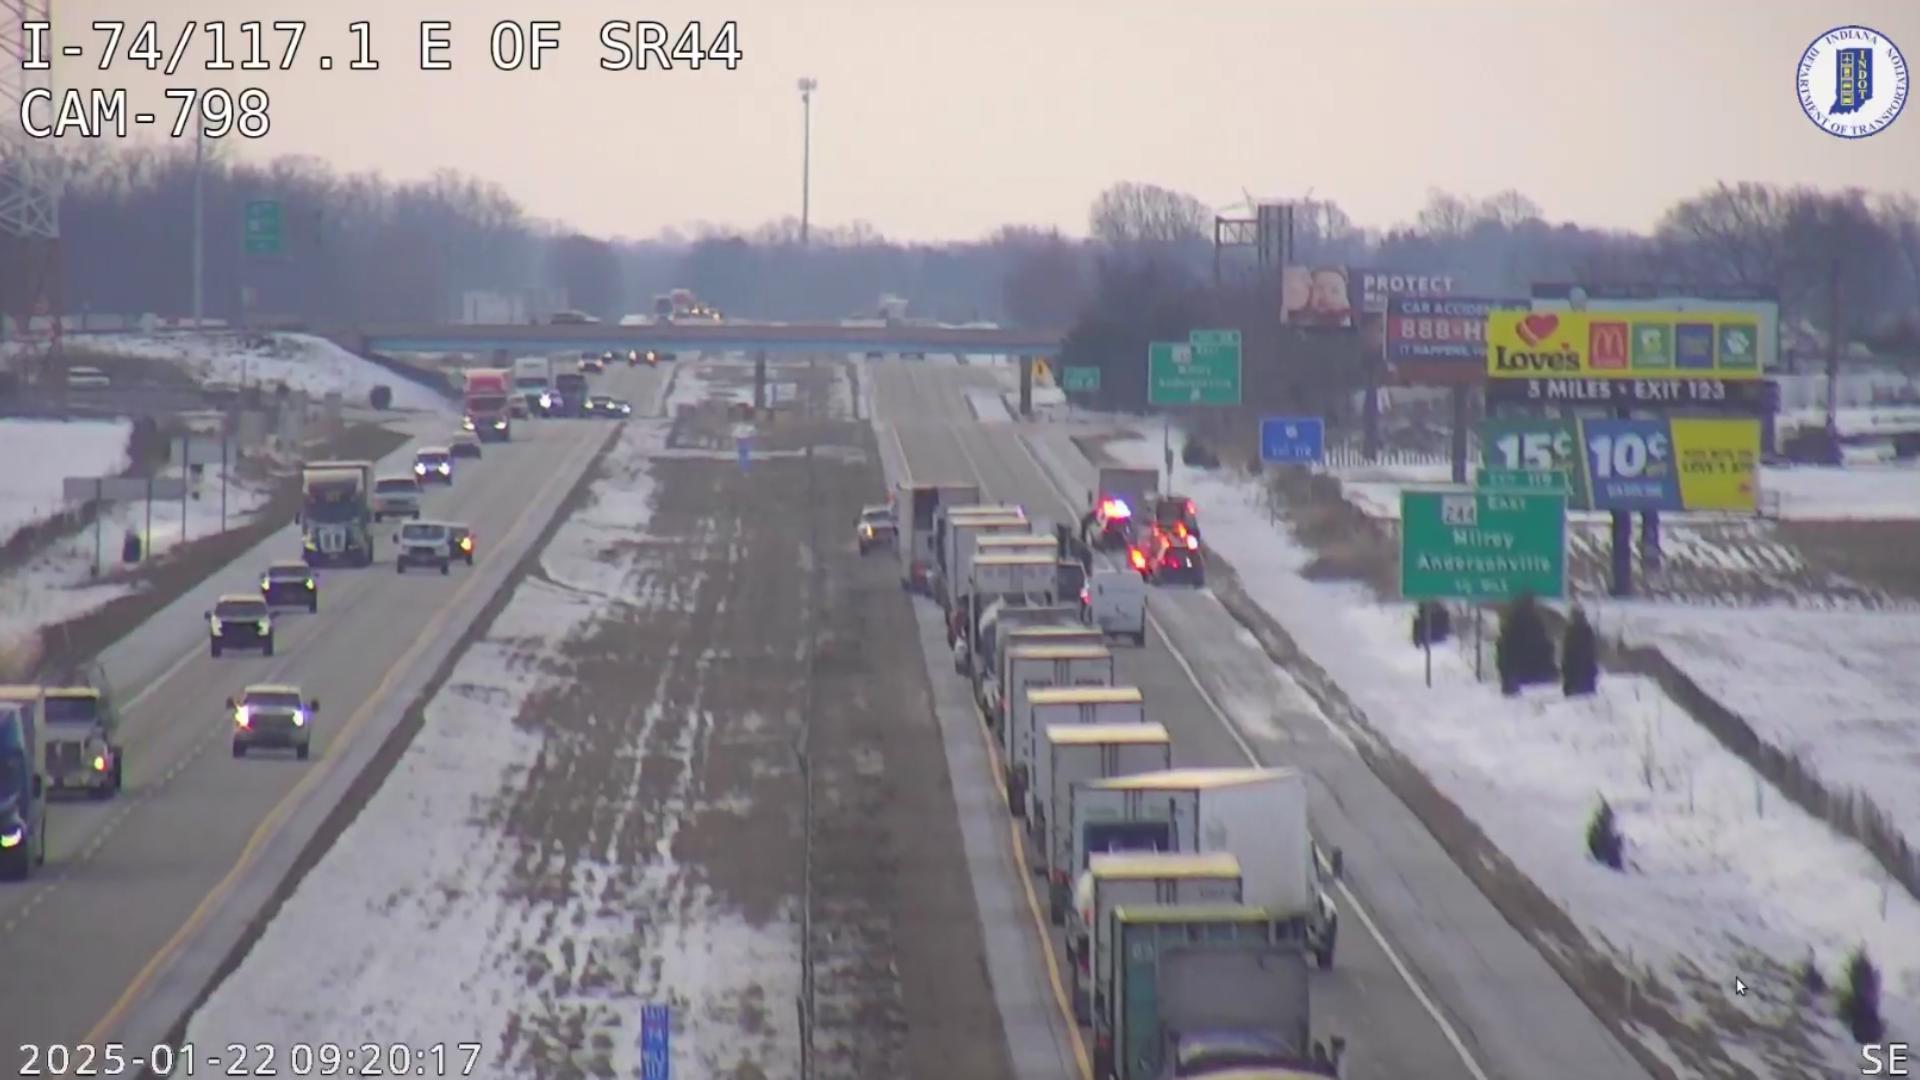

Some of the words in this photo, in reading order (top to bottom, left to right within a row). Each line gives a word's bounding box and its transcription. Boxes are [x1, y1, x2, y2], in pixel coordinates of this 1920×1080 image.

[1363, 274, 1453, 292] PROTECT
[1496, 343, 1581, 371] Love's
[1549, 380, 1611, 399] MILES
[1634, 381, 1678, 399] EXIT
[1689, 382, 1725, 399] 123
